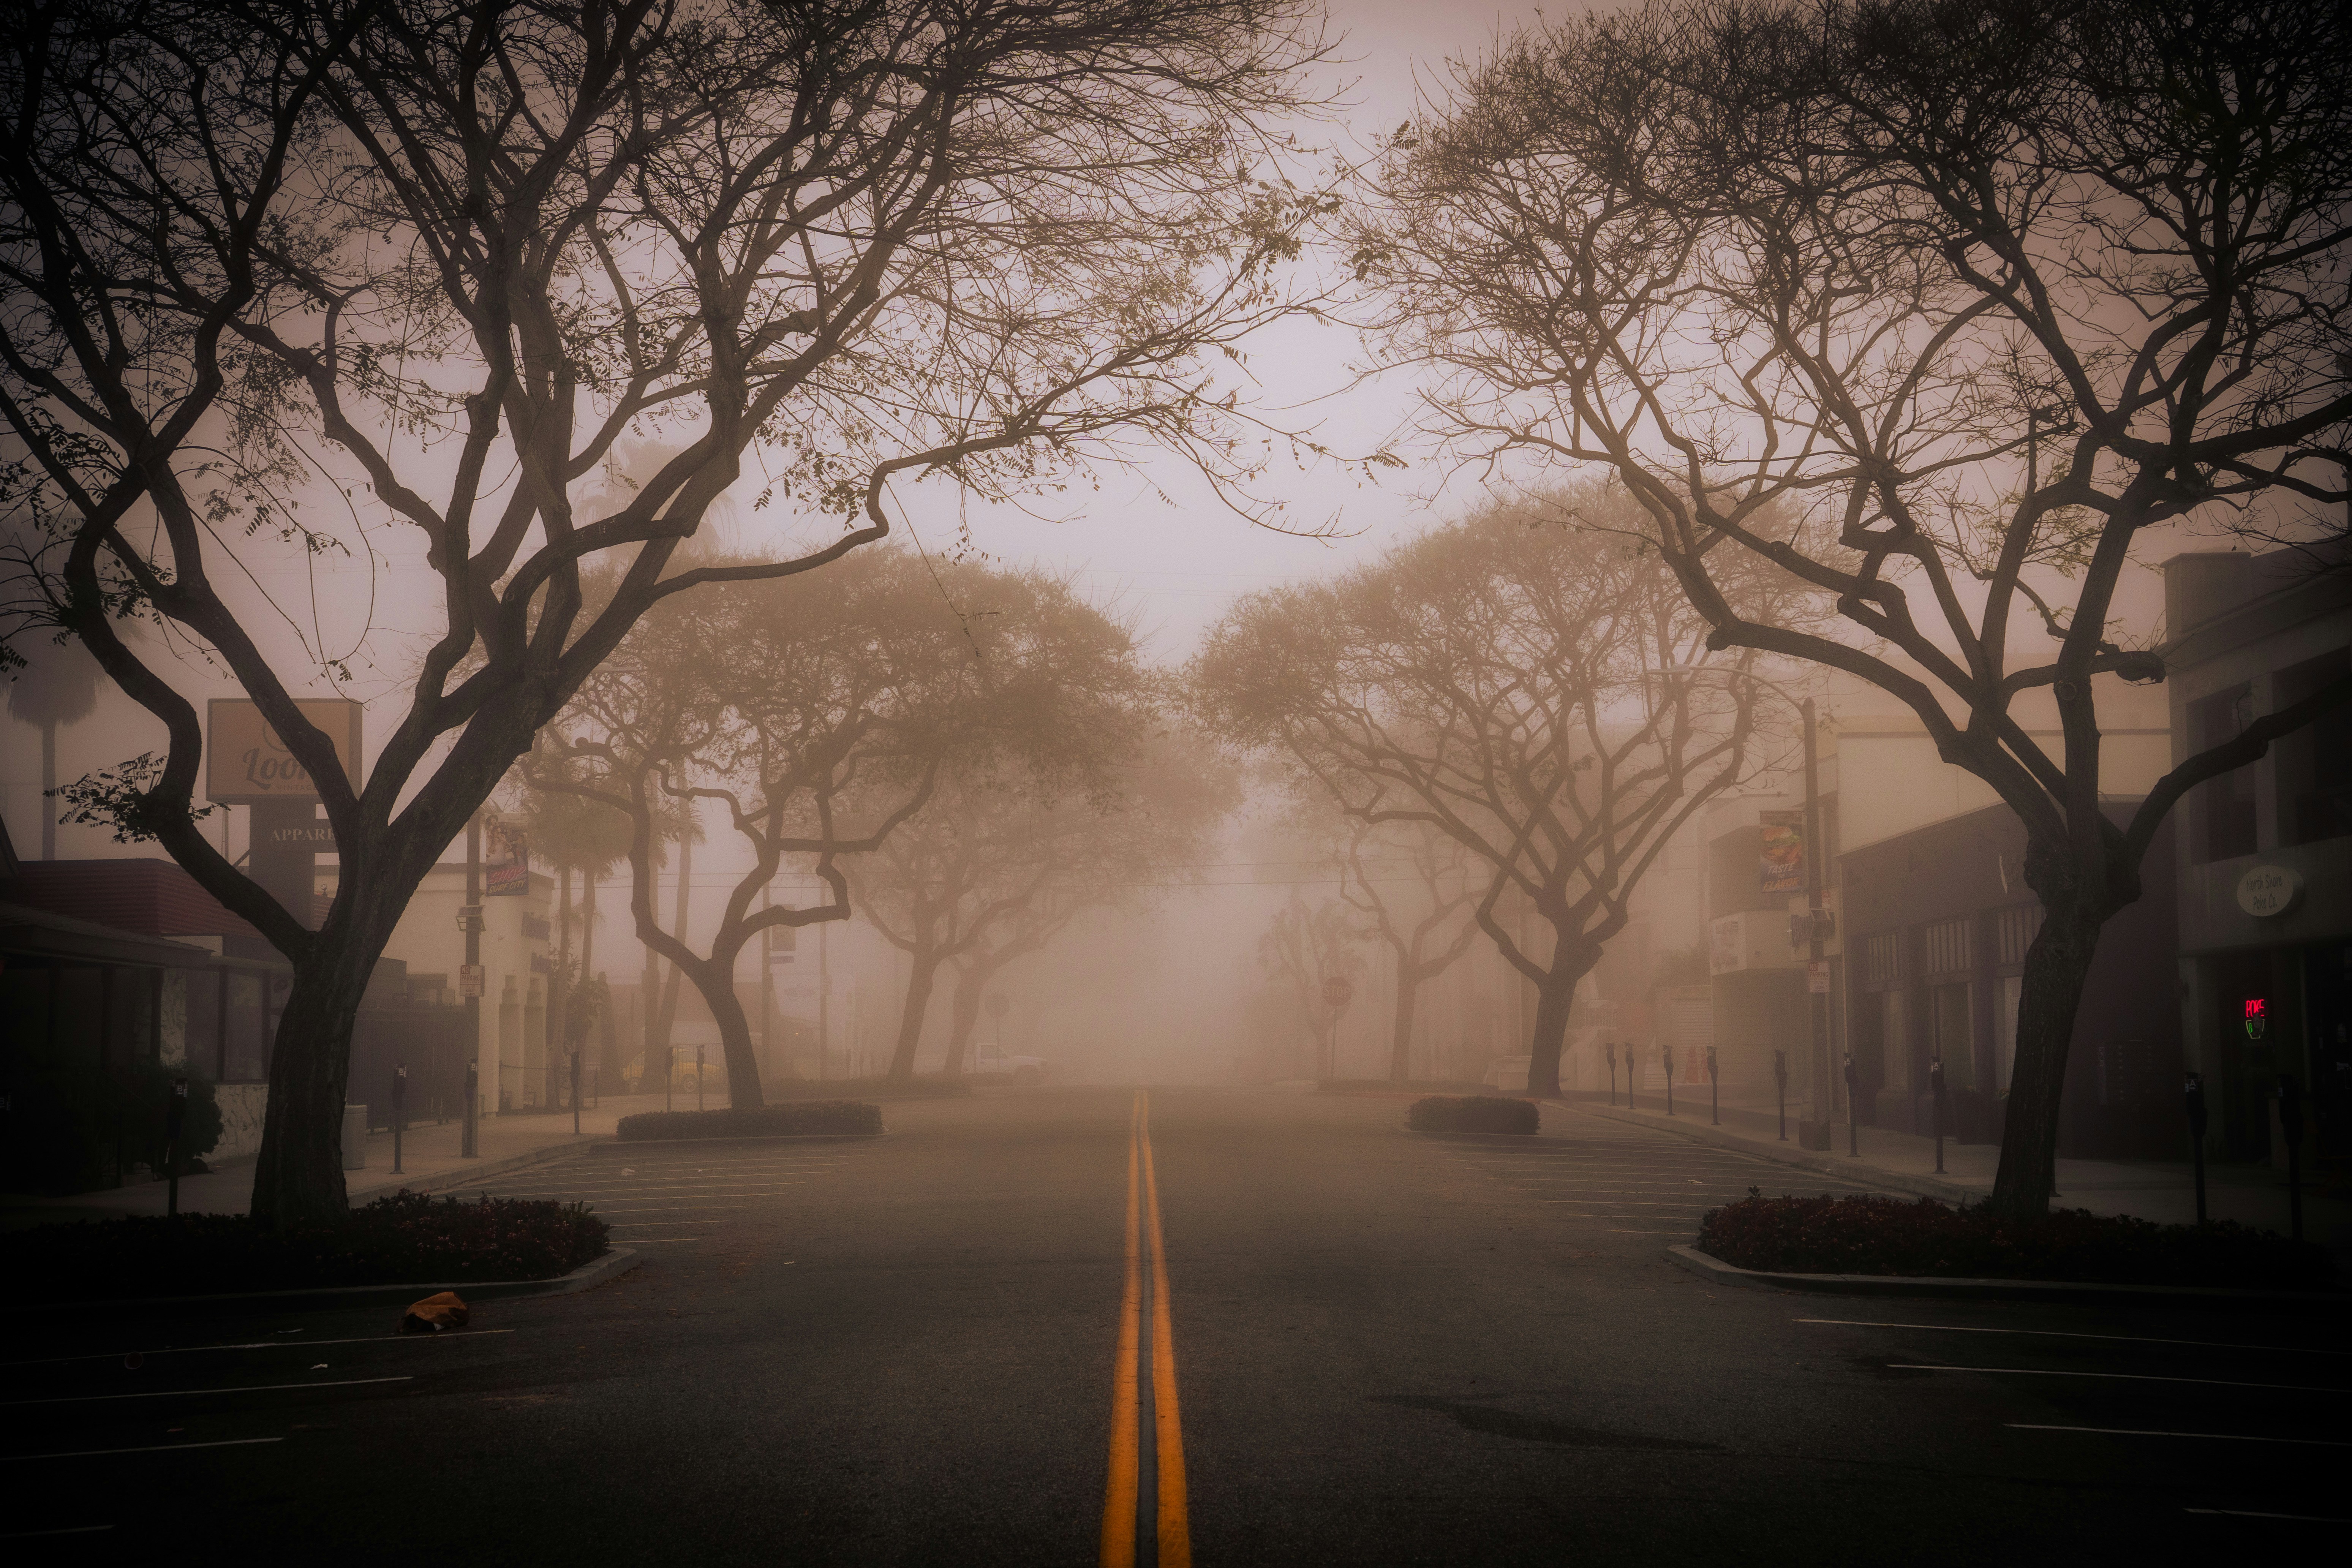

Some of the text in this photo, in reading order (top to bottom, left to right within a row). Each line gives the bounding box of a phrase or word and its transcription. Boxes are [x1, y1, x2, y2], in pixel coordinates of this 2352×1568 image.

[242, 748, 308, 790] Loo
[270, 828, 335, 841] APPARE
[488, 866, 526, 884] SHOP
[1768, 862, 1796, 875] TASTE
[488, 879, 526, 893] SURF CITY
[1763, 877, 1801, 891] FLAVOR
[2246, 873, 2282, 891] North Shore
[2253, 893, 2277, 910] Poke Co.
[1323, 985, 1350, 997] STOP
